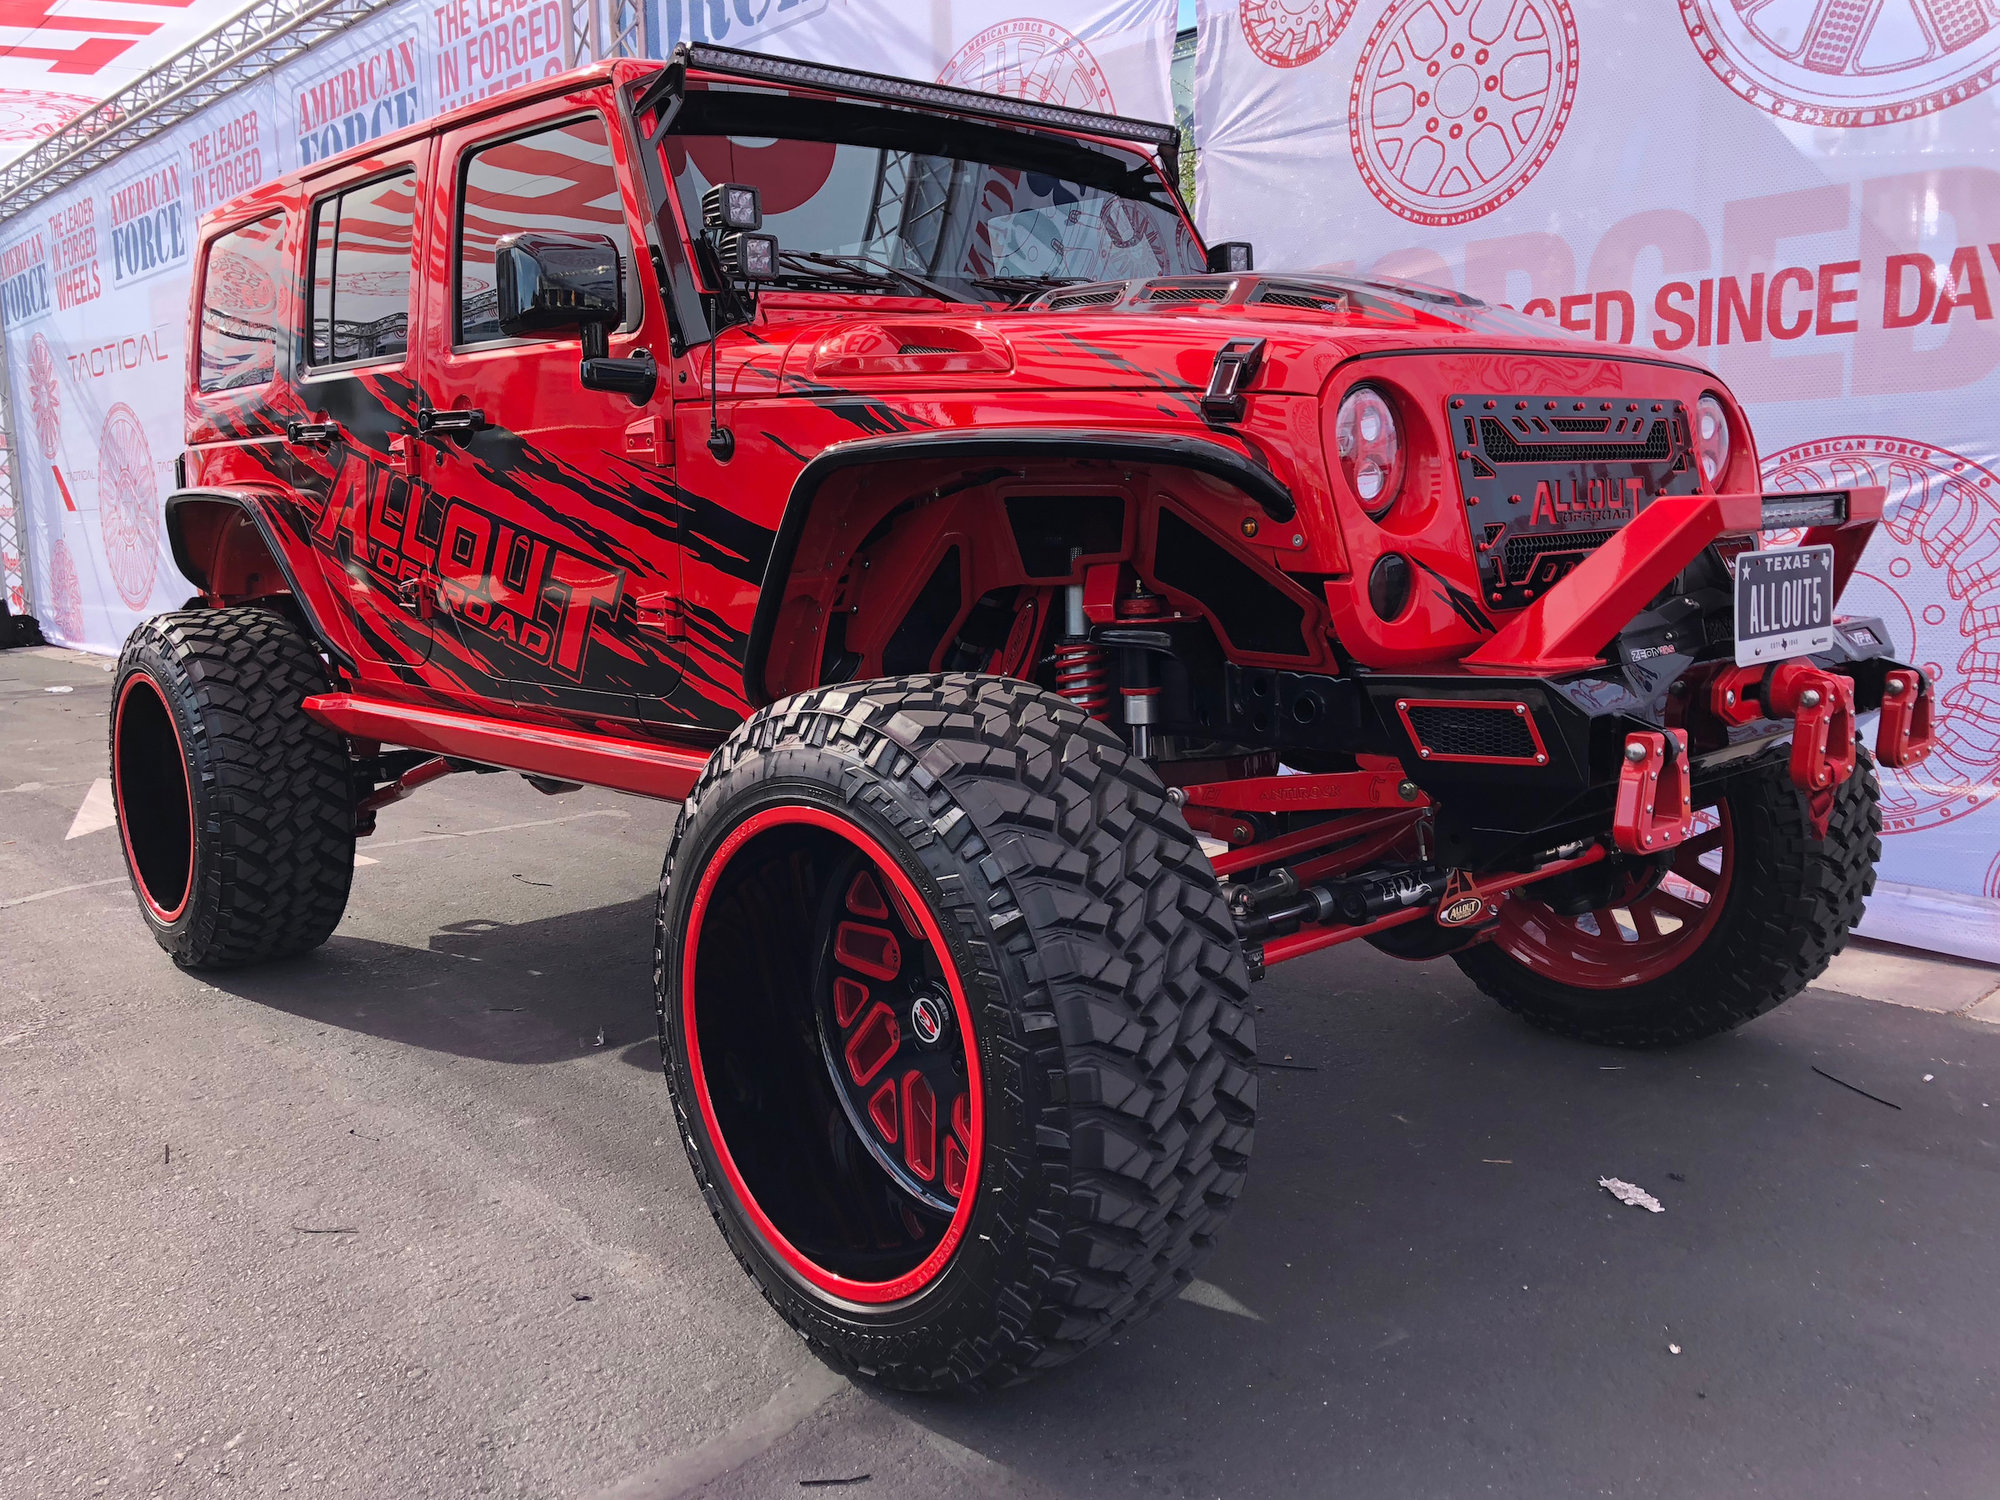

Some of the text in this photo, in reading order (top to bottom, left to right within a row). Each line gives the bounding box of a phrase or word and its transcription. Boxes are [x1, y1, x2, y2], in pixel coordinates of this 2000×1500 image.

[434, 0, 471, 47] THE
[437, 47, 460, 99] IN
[466, 1, 562, 86] FORGED
[963, 22, 1043, 58] AMERICAN FORCE
[298, 37, 416, 136] AMERICAN
[189, 110, 259, 172] THE LEADER
[110, 162, 181, 228] AMERICAN
[192, 147, 262, 211] IN FORGED
[49, 197, 95, 241] THE LEADER
[112, 203, 185, 281] FORCE
[52, 226, 97, 273] IN FORGED
[1, 263, 50, 325] FORCE
[55, 259, 101, 311] WHEELS
[1652, 260, 1861, 351] SINCE
[1882, 243, 2000, 329] DA
[67, 330, 169, 383] TACTICAL
[1779, 440, 1932, 465] AMERICAN FORCE
[1529, 477, 1644, 525] ALLOUT
[312, 446, 626, 683] ALLOUT
[1765, 553, 1810, 572] TEXAS
[1750, 577, 1822, 634] ALLOUT5
[1259, 785, 1341, 801] ANTIROCK
